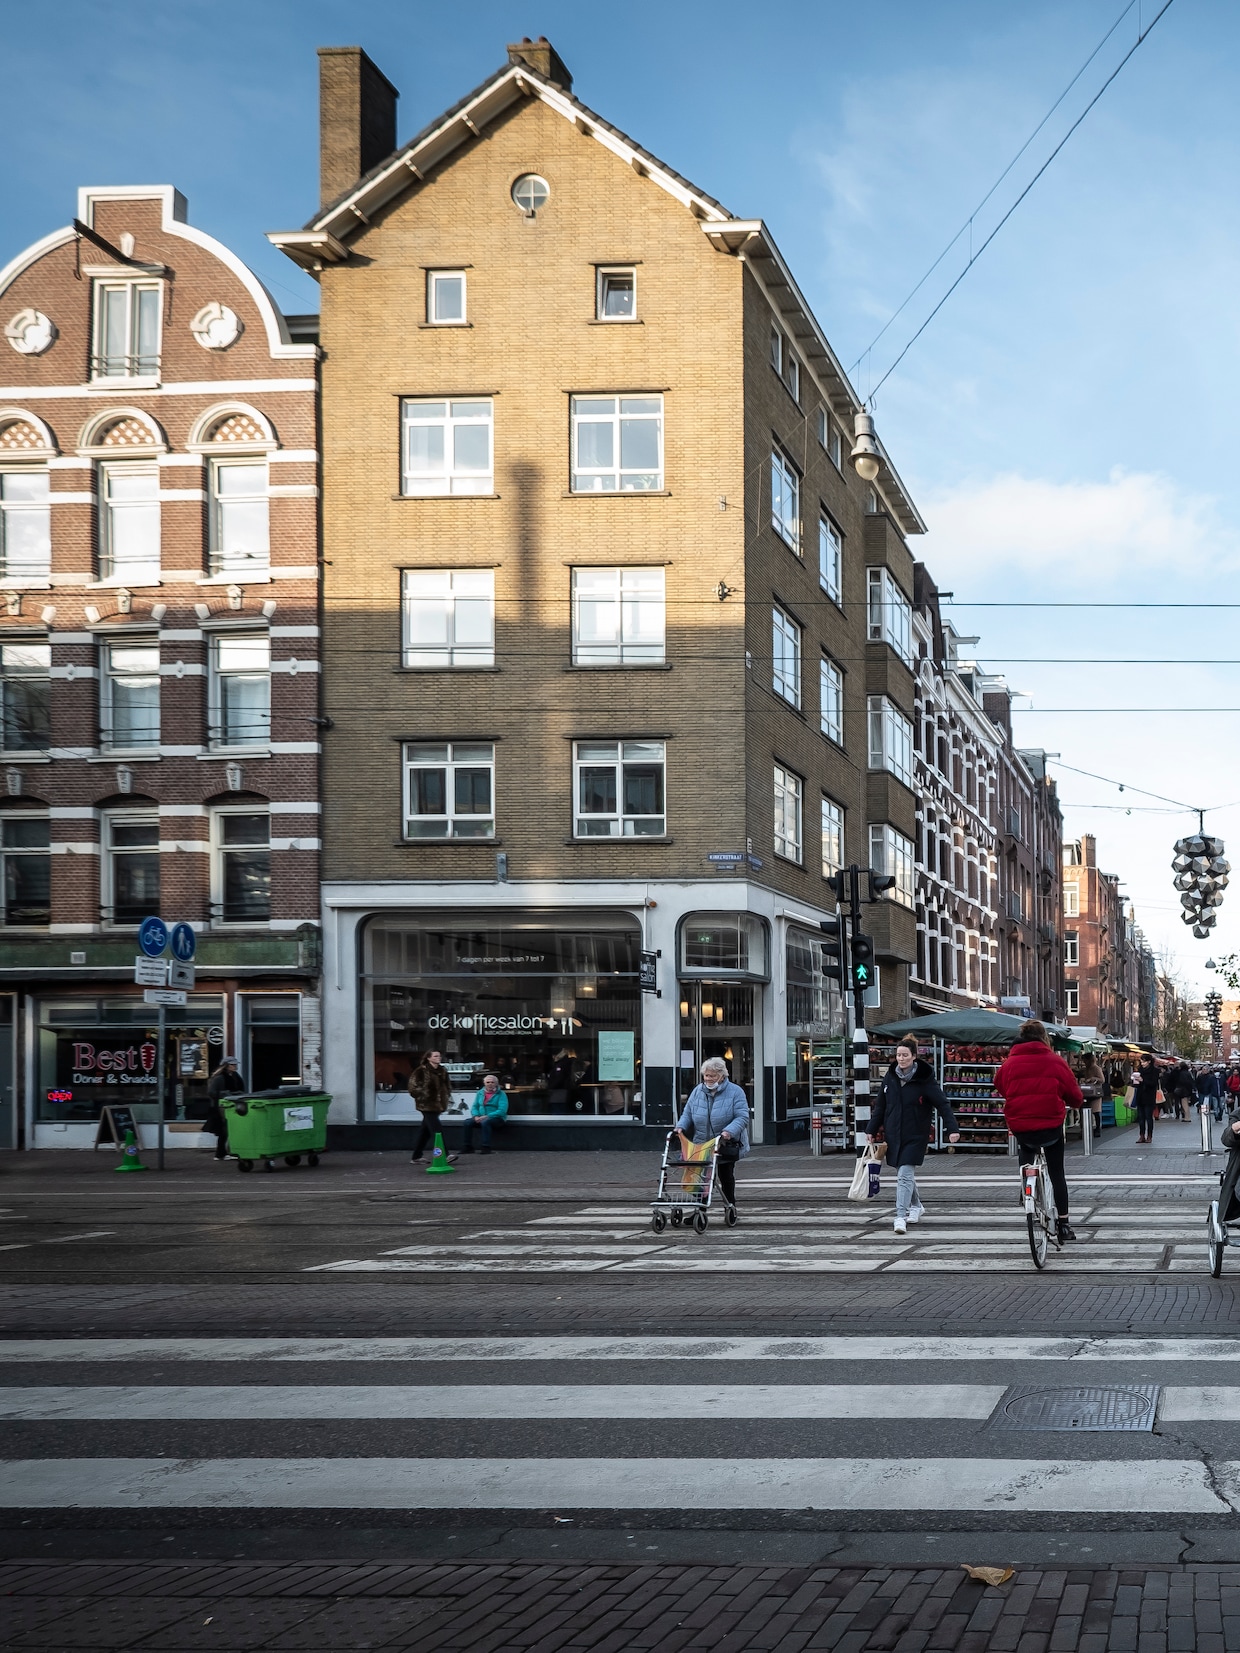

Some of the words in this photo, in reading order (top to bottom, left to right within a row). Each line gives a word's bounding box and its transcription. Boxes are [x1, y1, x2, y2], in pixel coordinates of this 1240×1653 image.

[428, 1014, 449, 1029] de
[453, 1014, 543, 1035] koffiesalon
[72, 1042, 138, 1071] Best
[106, 1073, 118, 1084] &
[120, 1073, 158, 1084] Snacks
[47, 1091, 73, 1101] OPEN
